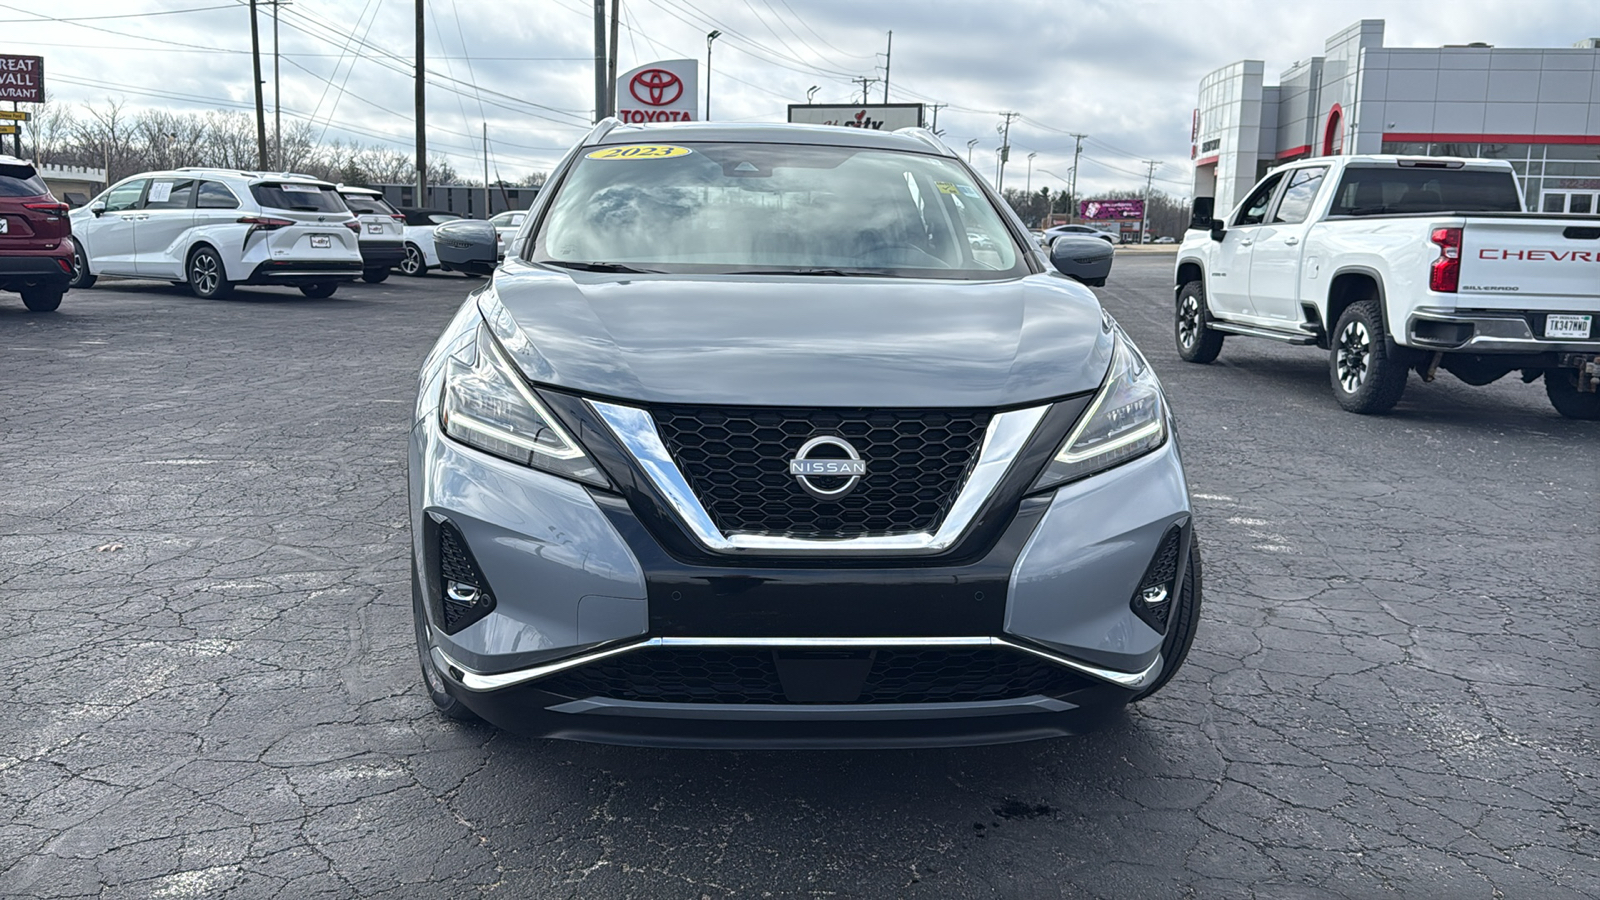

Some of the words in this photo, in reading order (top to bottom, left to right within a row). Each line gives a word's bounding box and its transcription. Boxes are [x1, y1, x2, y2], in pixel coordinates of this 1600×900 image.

[620, 109, 692, 124] TOYOTA
[603, 147, 675, 159] 2023
[792, 462, 865, 473] NISSAN
